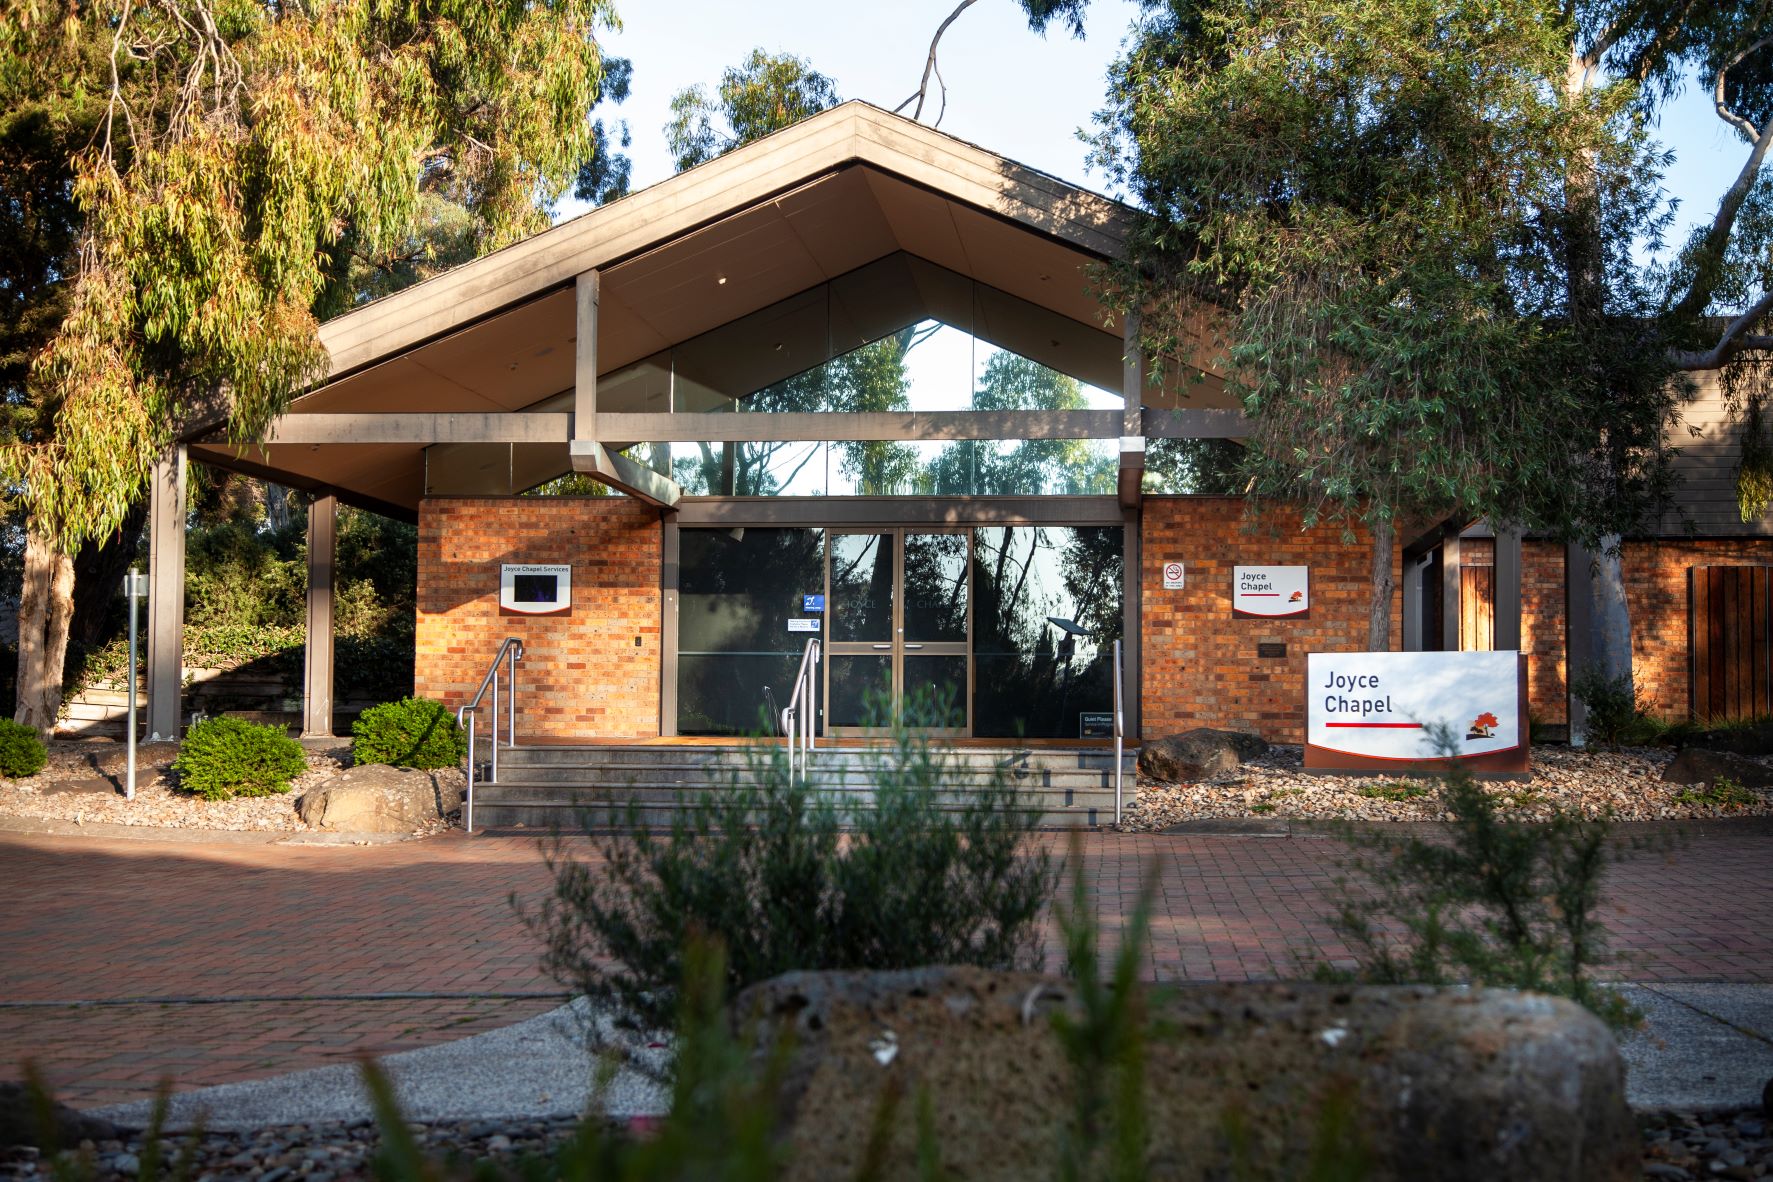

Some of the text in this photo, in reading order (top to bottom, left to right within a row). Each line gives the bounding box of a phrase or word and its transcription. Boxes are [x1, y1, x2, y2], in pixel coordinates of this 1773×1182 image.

[1241, 572, 1267, 582] Joyce
[1240, 582, 1272, 592] Chapel
[847, 600, 876, 609] JOYCE
[1324, 671, 1379, 693] Joyce
[1325, 695, 1392, 717] Chapel
